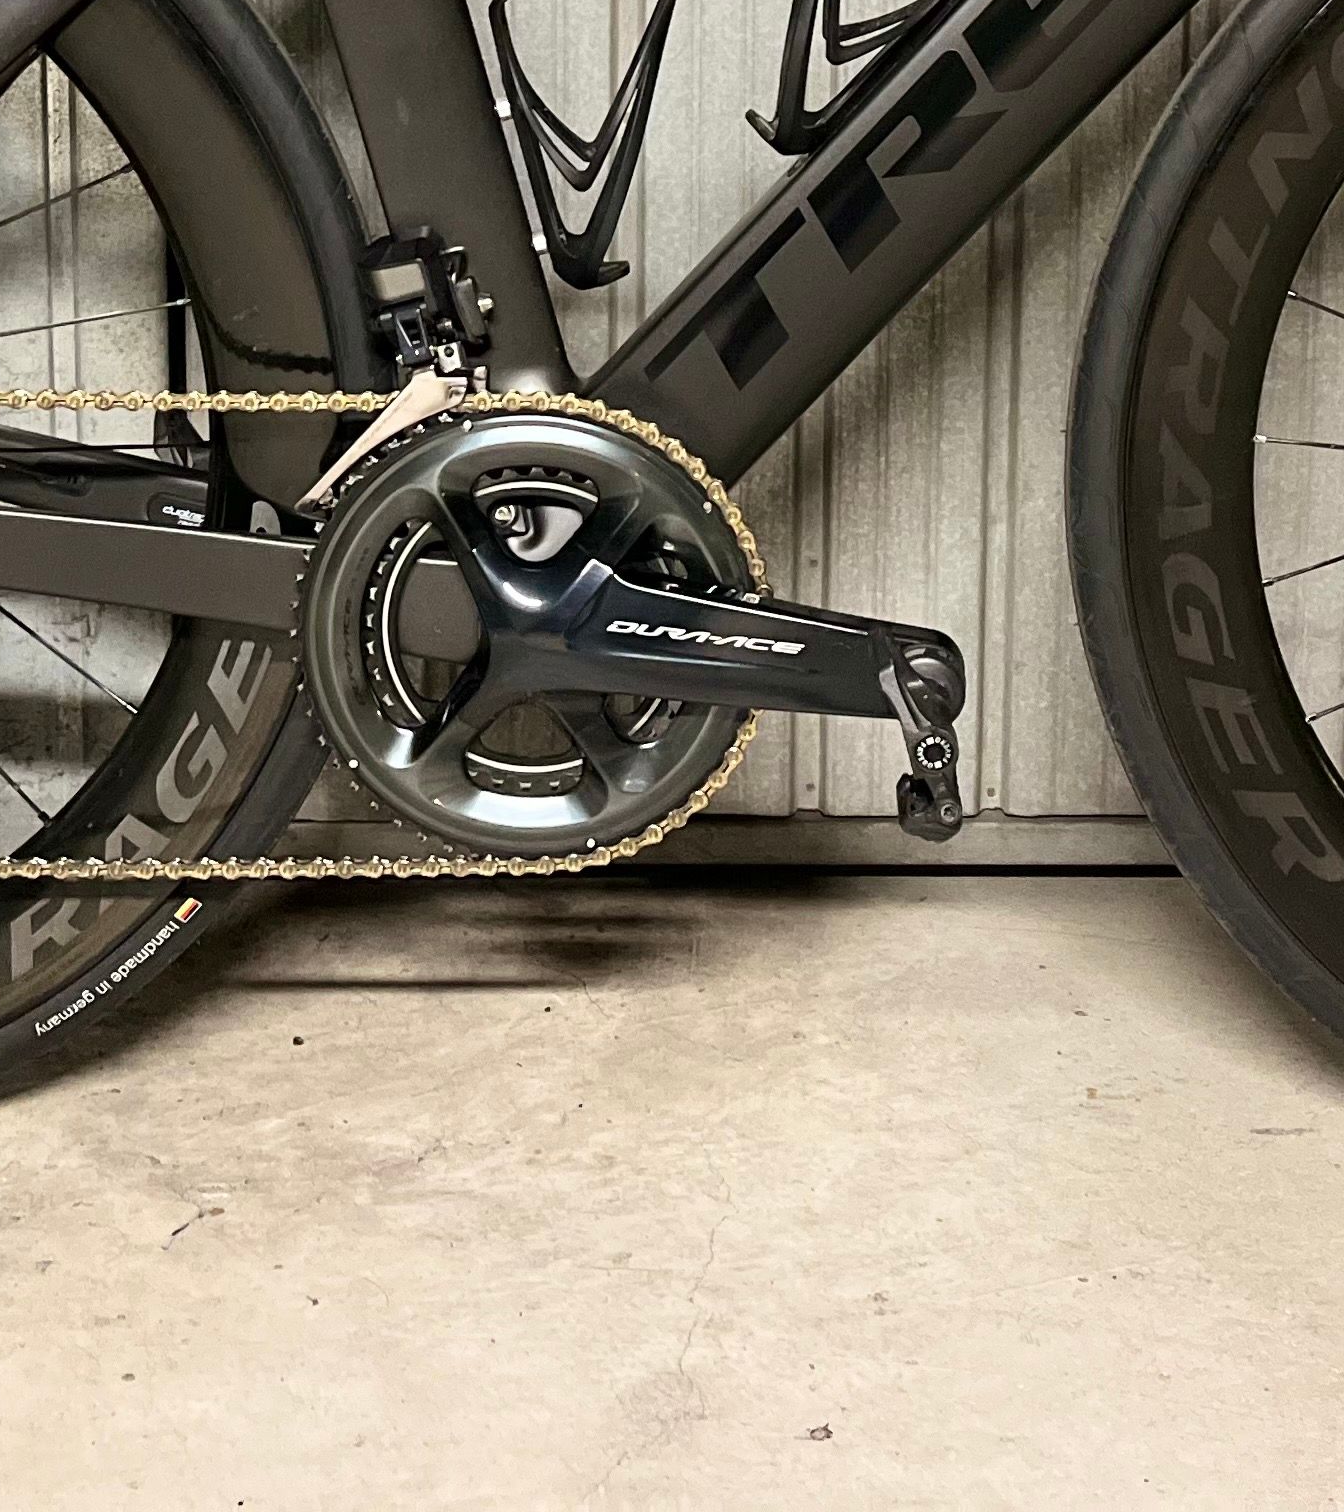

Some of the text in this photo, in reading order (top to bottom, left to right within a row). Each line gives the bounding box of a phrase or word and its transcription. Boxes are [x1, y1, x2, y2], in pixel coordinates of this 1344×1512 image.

[606, 620, 805, 655] DURA-ACE
[34, 920, 180, 1037] handmade in germany
